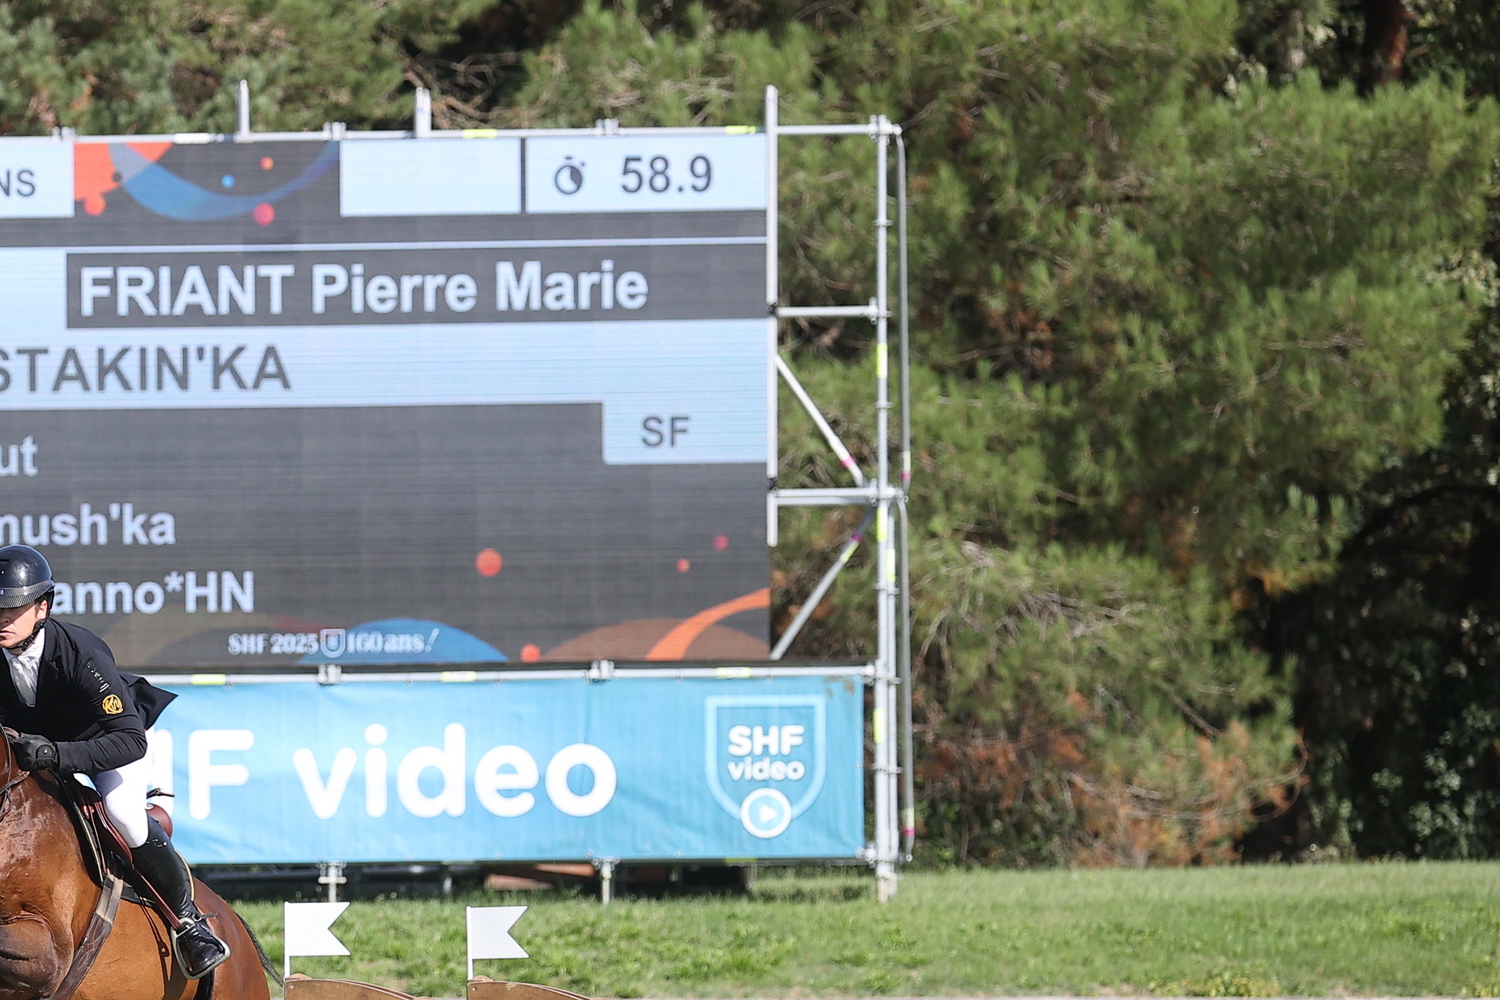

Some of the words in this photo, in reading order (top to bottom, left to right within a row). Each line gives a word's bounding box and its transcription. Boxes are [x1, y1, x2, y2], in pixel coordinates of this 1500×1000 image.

[621, 154, 713, 194] 58.9
[80, 264, 295, 316] FRIANT
[311, 262, 477, 314] Pierre
[496, 259, 649, 311] Marie
[641, 415, 690, 448] SF
[228, 632, 267, 655] SHF
[270, 632, 319, 655] 2025
[727, 724, 806, 757] SHF
[292, 722, 618, 820] video
[727, 756, 806, 781] video
